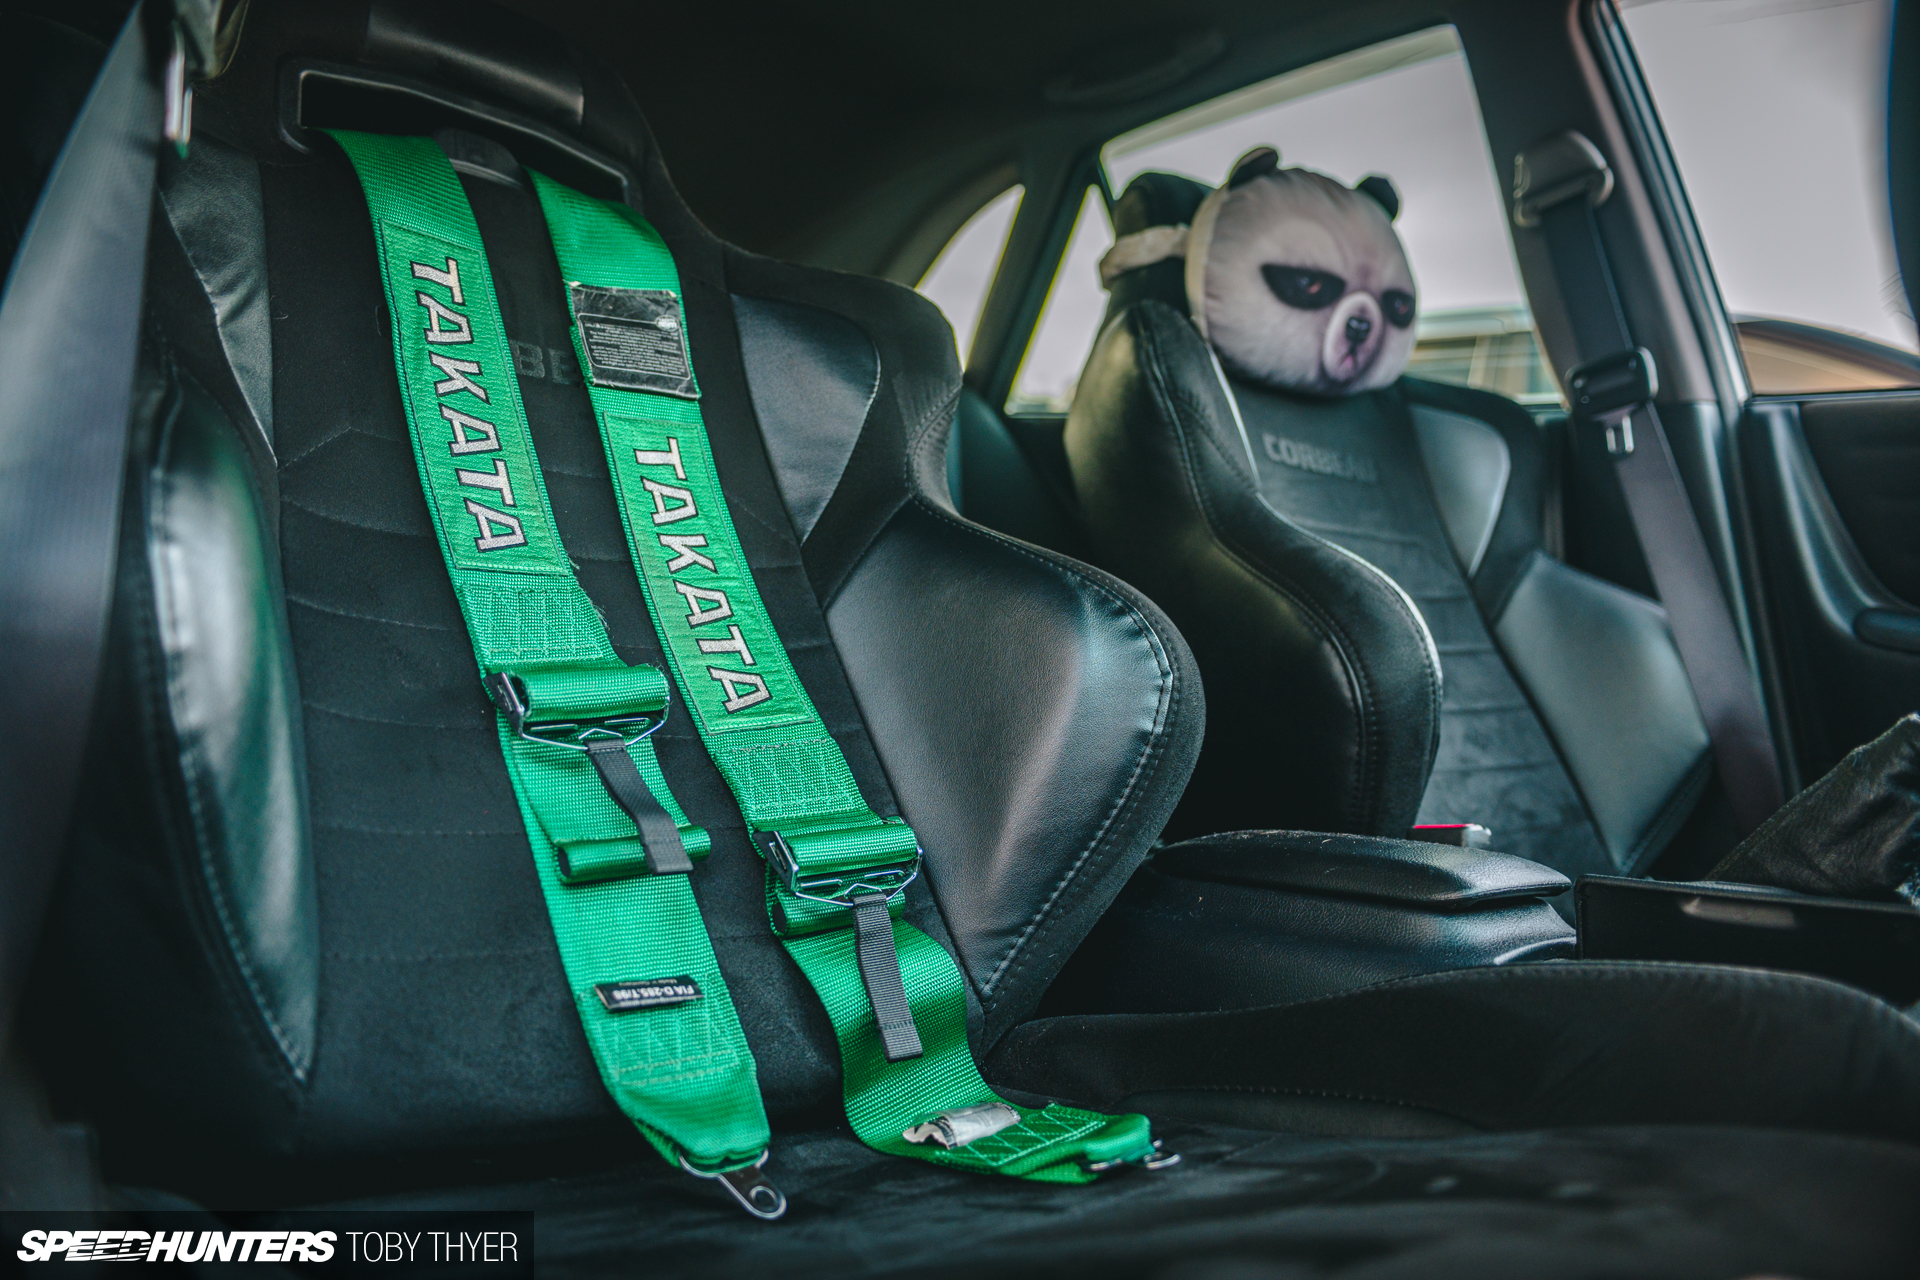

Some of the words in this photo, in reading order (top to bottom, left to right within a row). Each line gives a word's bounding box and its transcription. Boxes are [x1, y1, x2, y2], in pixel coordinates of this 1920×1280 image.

[410, 257, 528, 553] TAKATA
[634, 436, 771, 714] TAKATA
[673, 985, 695, 995] FIA
